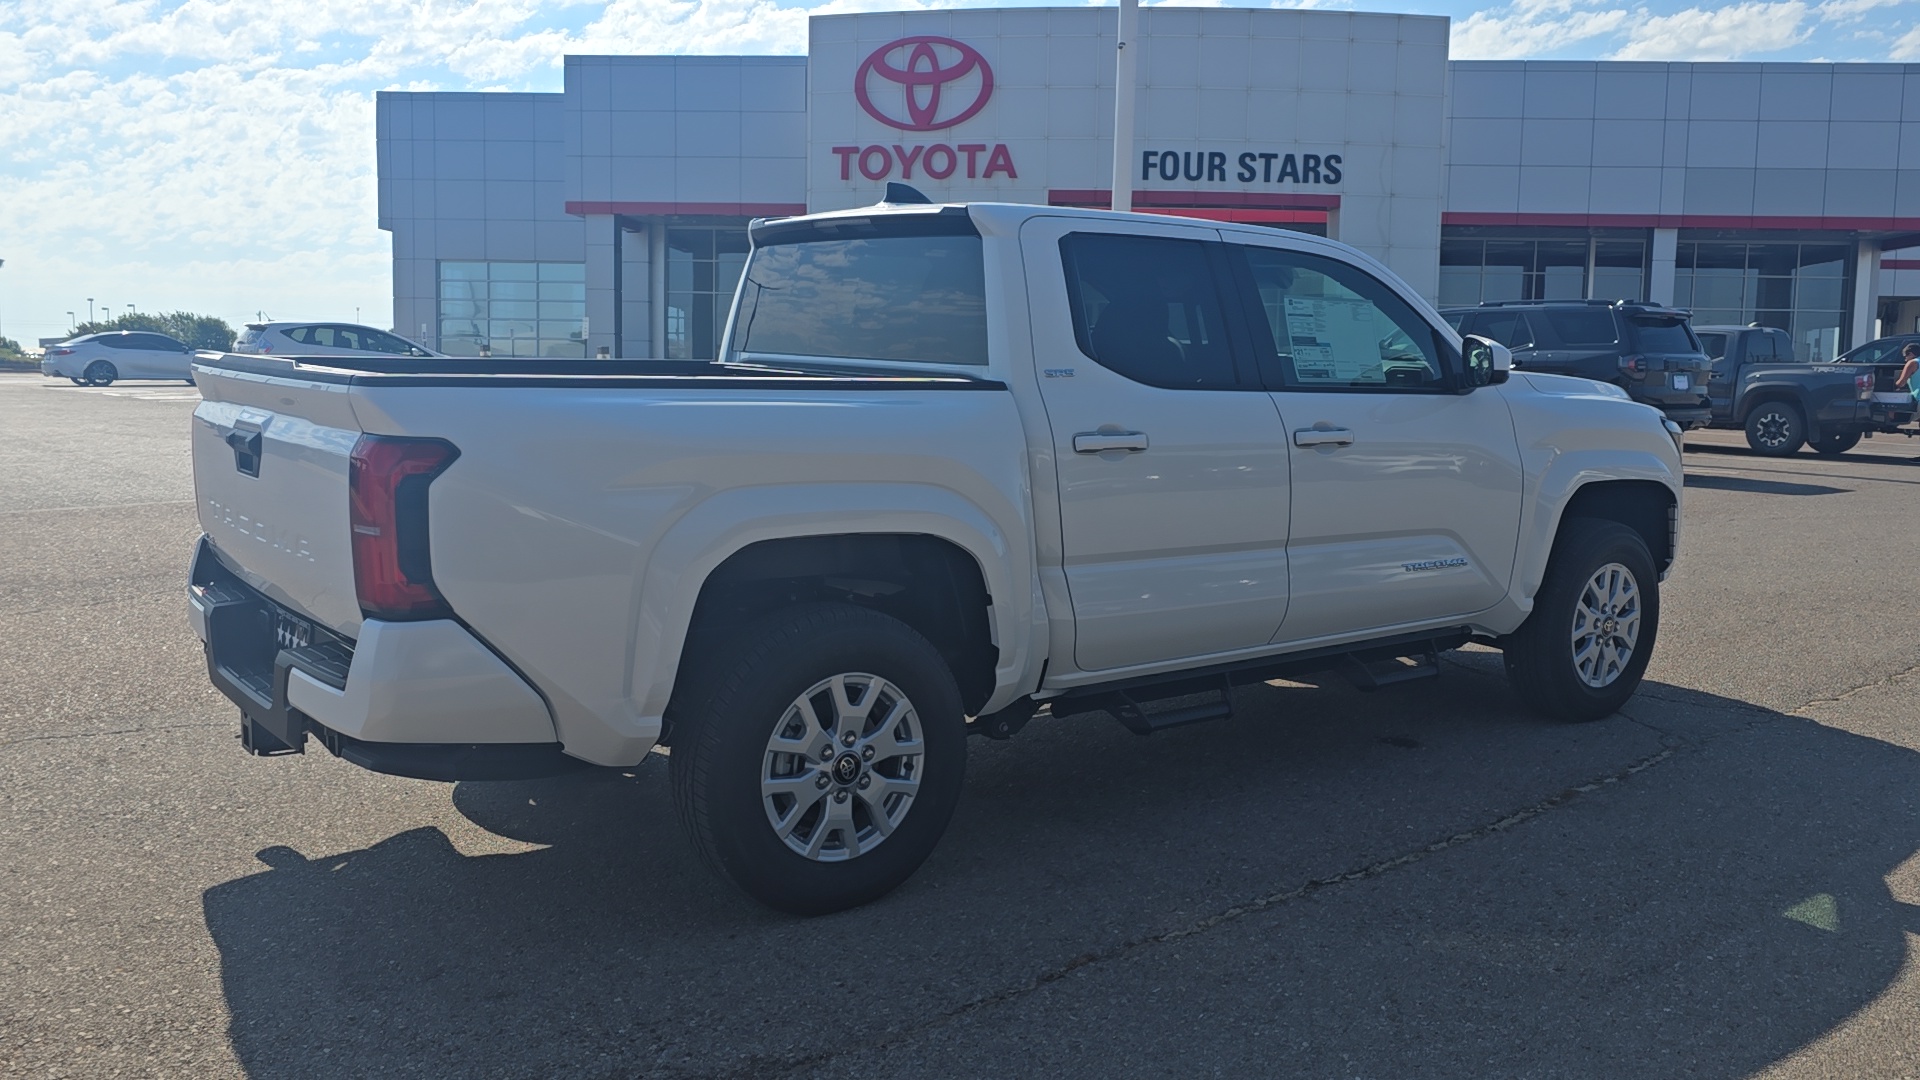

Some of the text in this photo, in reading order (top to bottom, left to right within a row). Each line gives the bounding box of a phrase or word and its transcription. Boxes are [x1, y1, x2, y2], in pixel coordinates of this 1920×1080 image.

[832, 143, 1018, 181] TOYOTA
[1142, 150, 1343, 185] FOUR STARS
[1401, 557, 1468, 572] TACOMA
